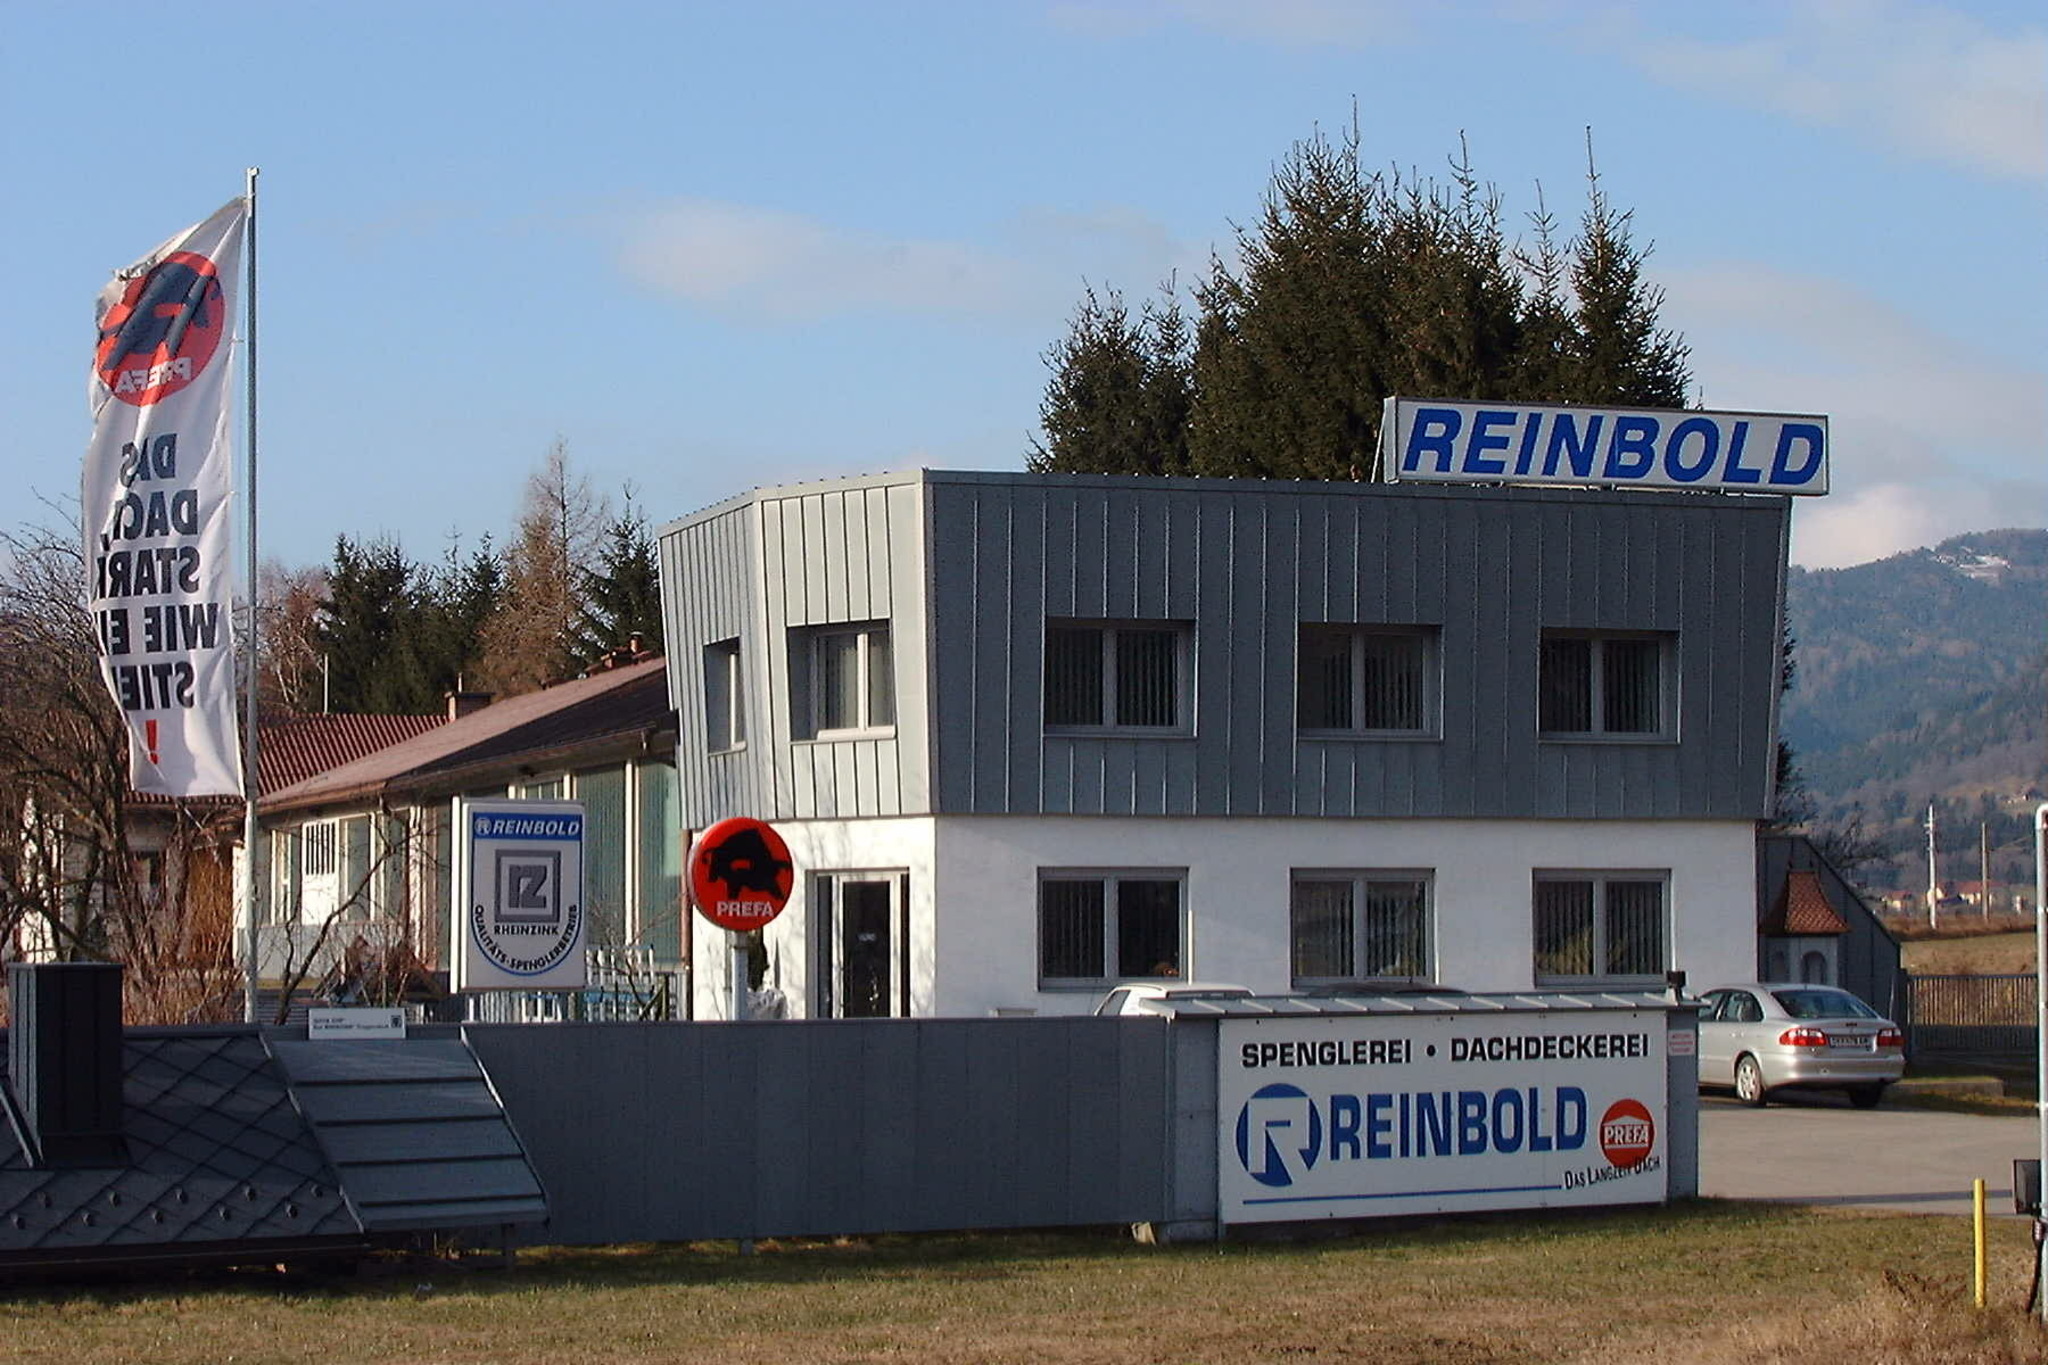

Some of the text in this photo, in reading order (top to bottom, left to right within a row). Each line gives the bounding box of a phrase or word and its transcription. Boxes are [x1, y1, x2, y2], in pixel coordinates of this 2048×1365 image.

[1401, 407, 1825, 486] REINBOLD
[492, 819, 580, 837] REINBOLD
[716, 901, 775, 918] PREFA
[493, 924, 560, 937] RHEINZINK
[1241, 1038, 1412, 1068] SPENGLEREI
[1450, 1033, 1649, 1063] DACHDECKEREI
[1330, 1086, 1587, 1161] REINBOLD
[1603, 1125, 1650, 1146] PREFA
